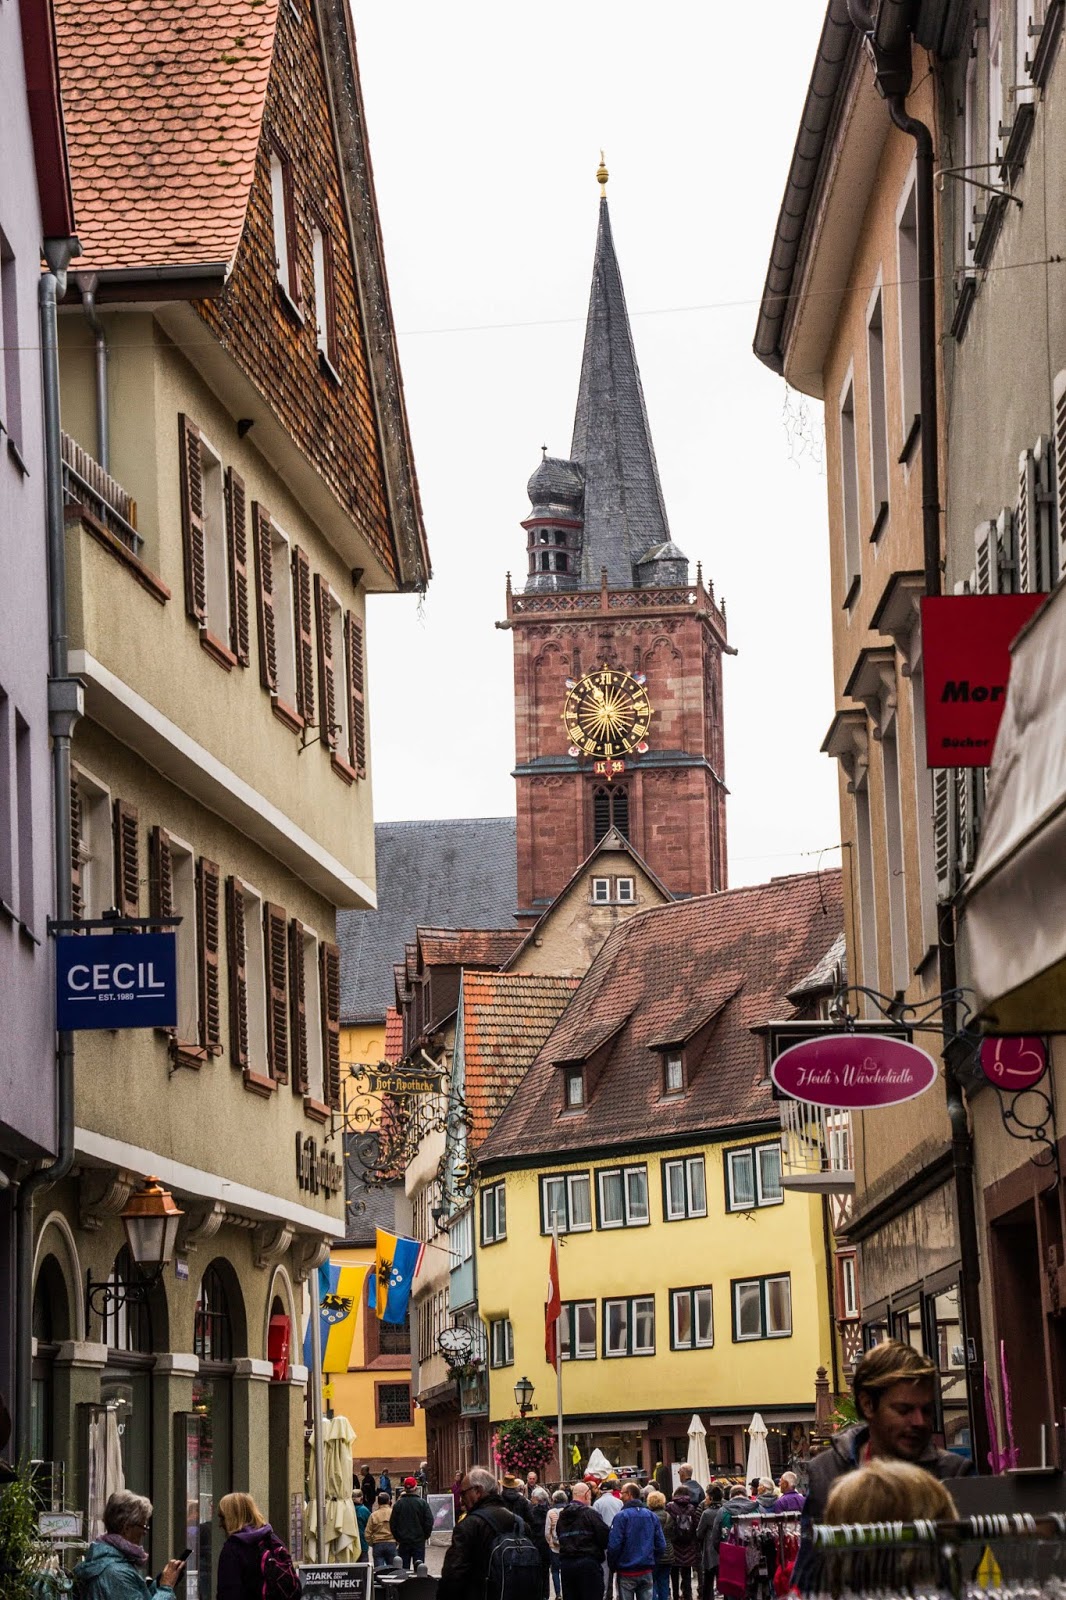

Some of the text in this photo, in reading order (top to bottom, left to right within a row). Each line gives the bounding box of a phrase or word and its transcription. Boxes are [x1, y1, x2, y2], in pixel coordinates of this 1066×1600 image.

[68, 963, 165, 991] CECIL
[98, 993, 116, 1001] EST.
[306, 1572, 333, 1581] STARK
[329, 1579, 361, 1588] INFEKT
